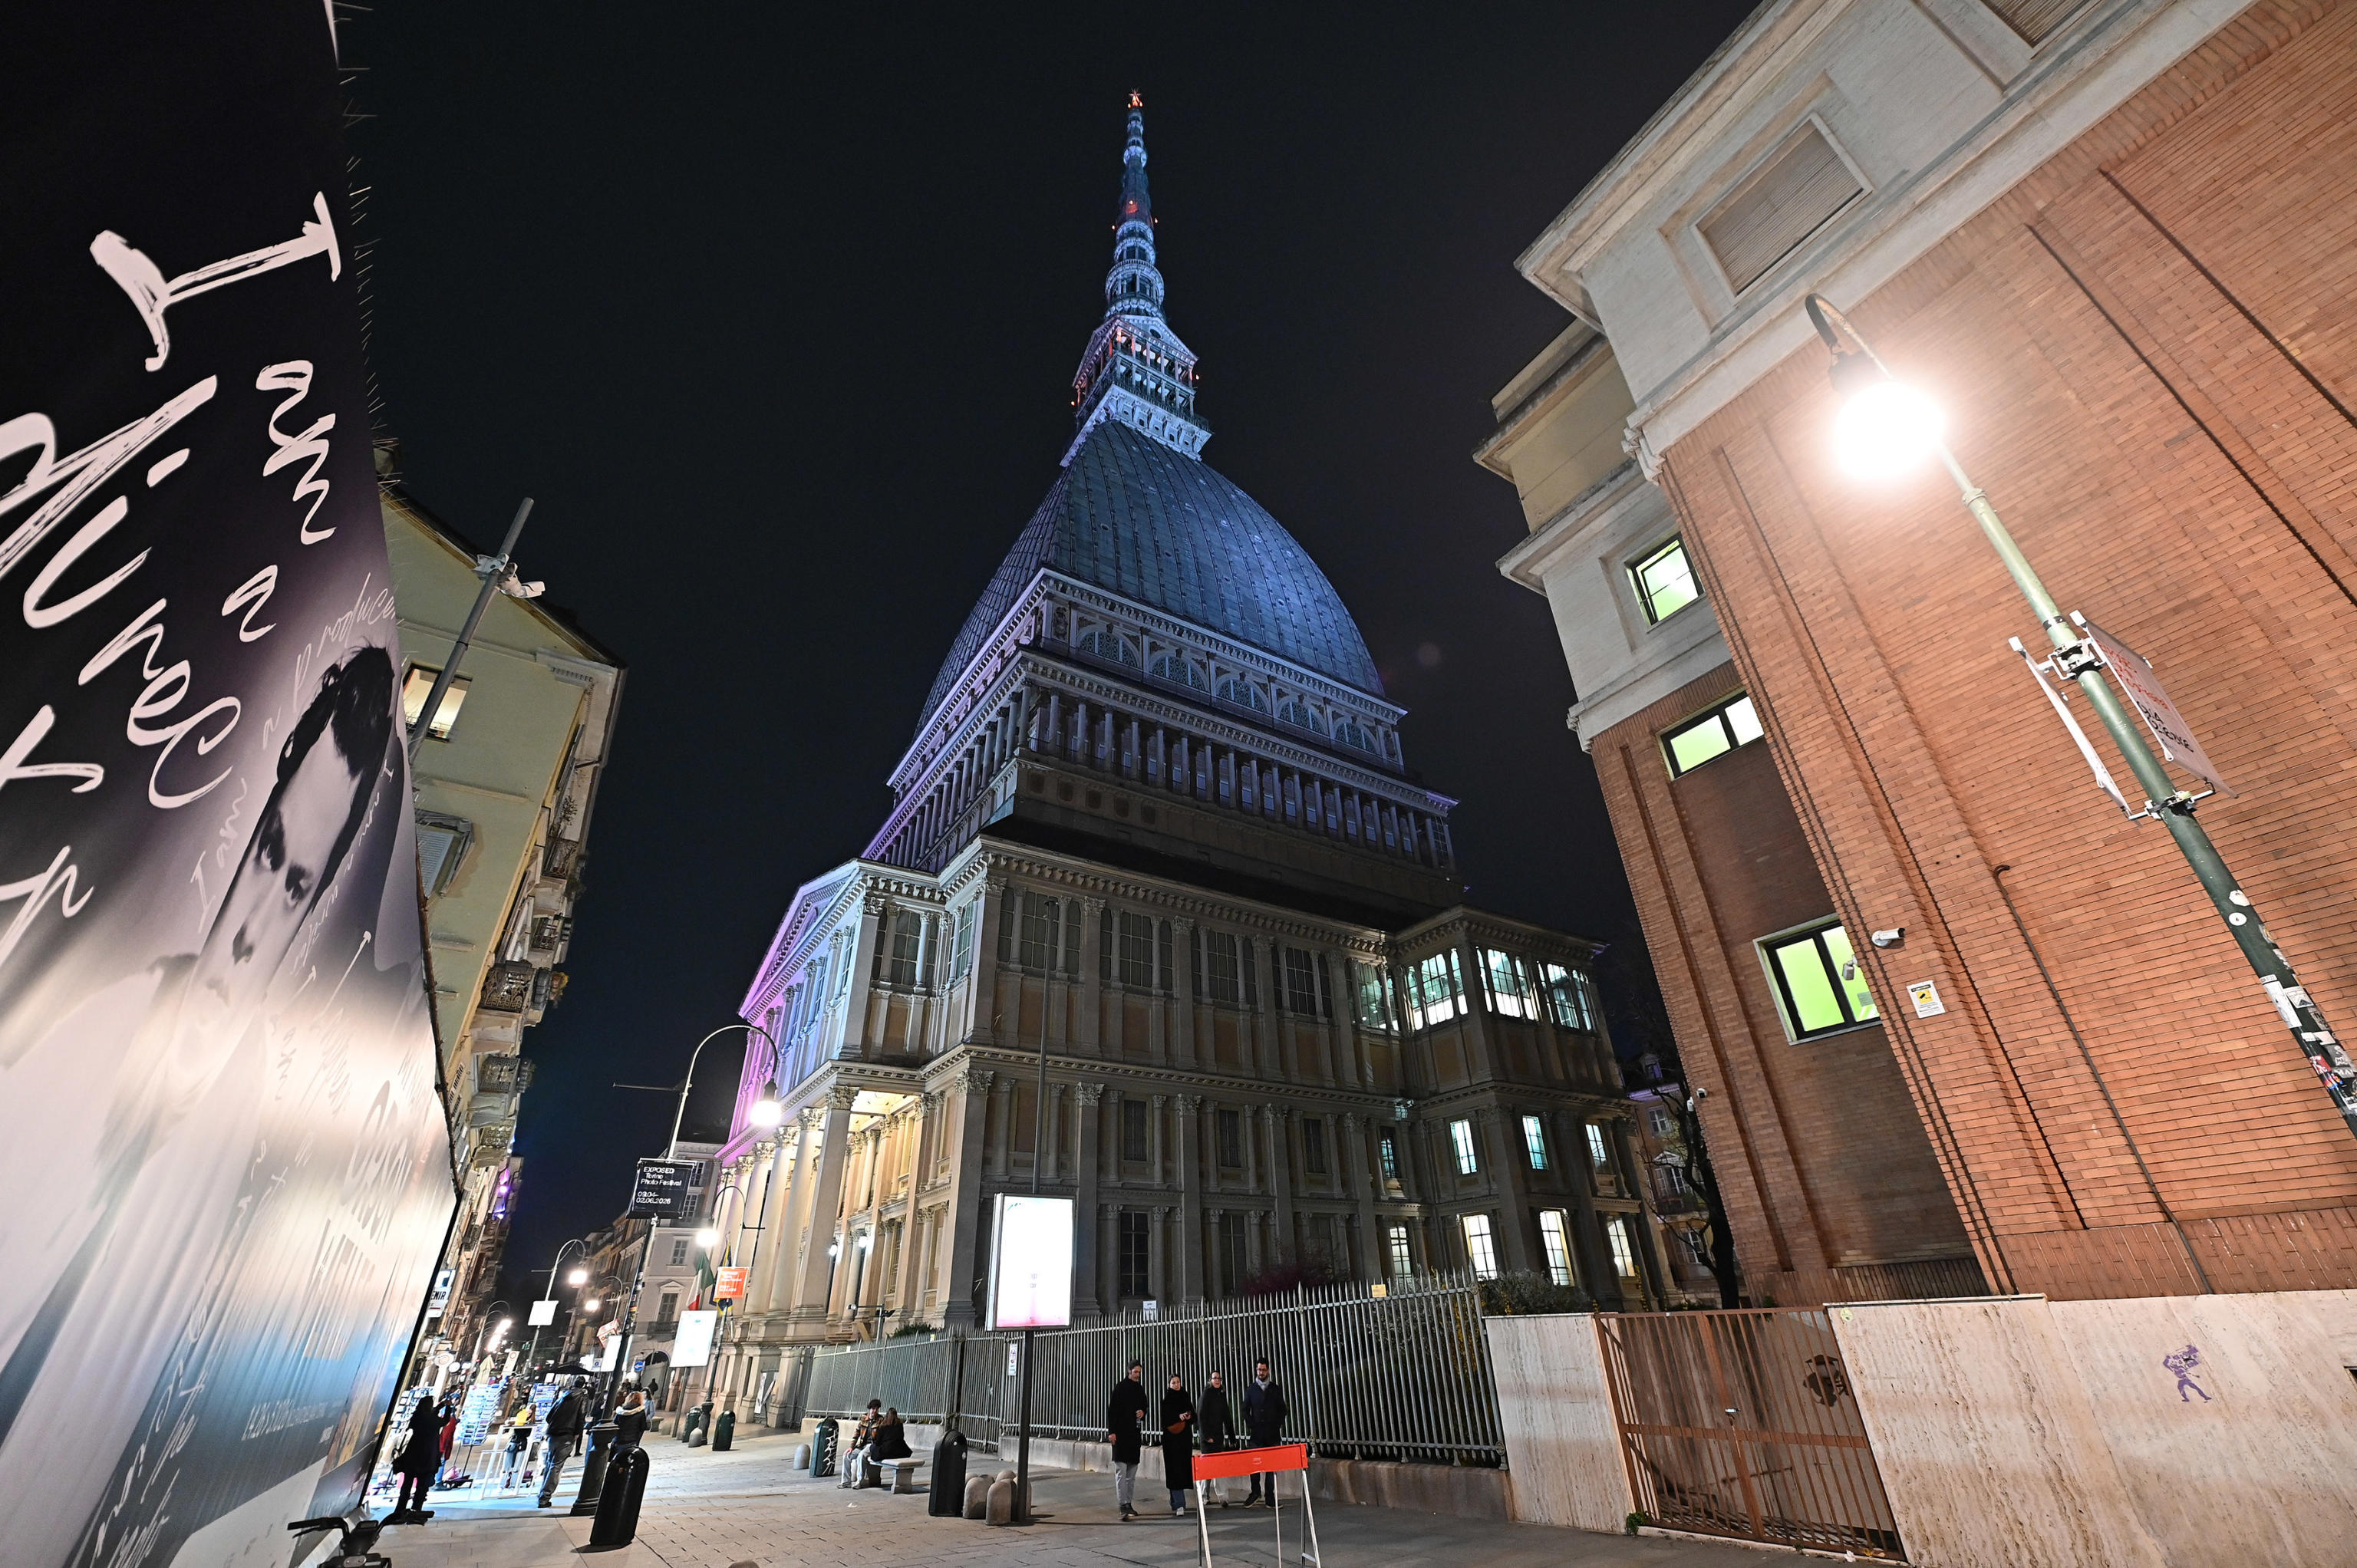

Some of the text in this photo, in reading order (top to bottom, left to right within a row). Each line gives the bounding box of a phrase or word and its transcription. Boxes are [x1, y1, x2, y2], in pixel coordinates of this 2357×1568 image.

[256, 359, 336, 545] am
[221, 565, 279, 644] a
[340, 1079, 413, 1244] ORSON
